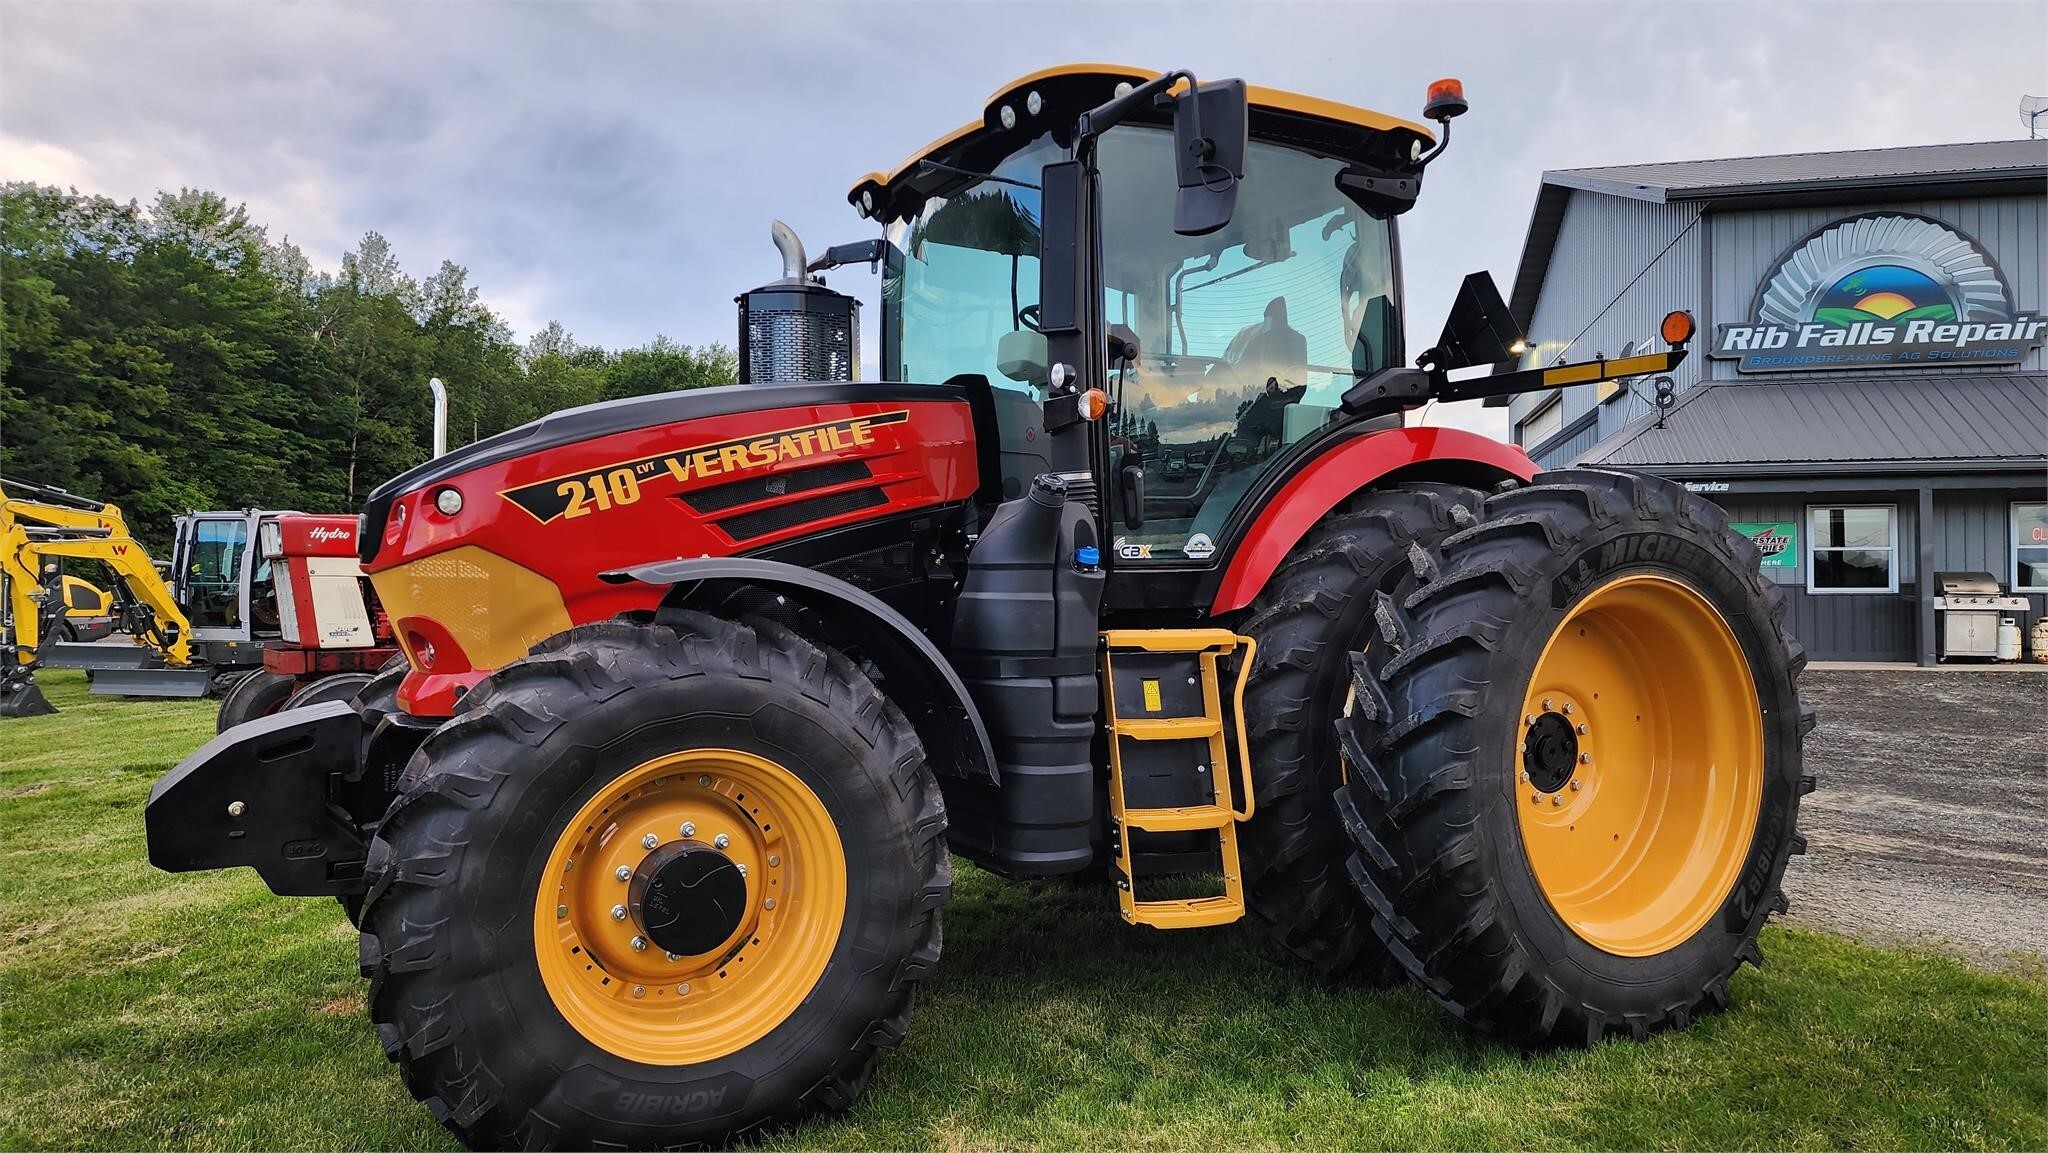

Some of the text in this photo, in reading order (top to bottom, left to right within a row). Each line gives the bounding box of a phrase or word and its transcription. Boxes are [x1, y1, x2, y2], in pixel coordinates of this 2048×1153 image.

[1722, 317, 2047, 351] Rib Falls Repair
[1749, 348, 2019, 367] GROUNDBREAKING AG SOLUTIONS
[556, 420, 876, 520] 210 CVT VERSATILE
[310, 526, 350, 544] Hydro
[1748, 536, 1789, 545] RSTATE
[1121, 546, 1152, 558] CBX
[612, 1085, 728, 1115] AGRIBIB
